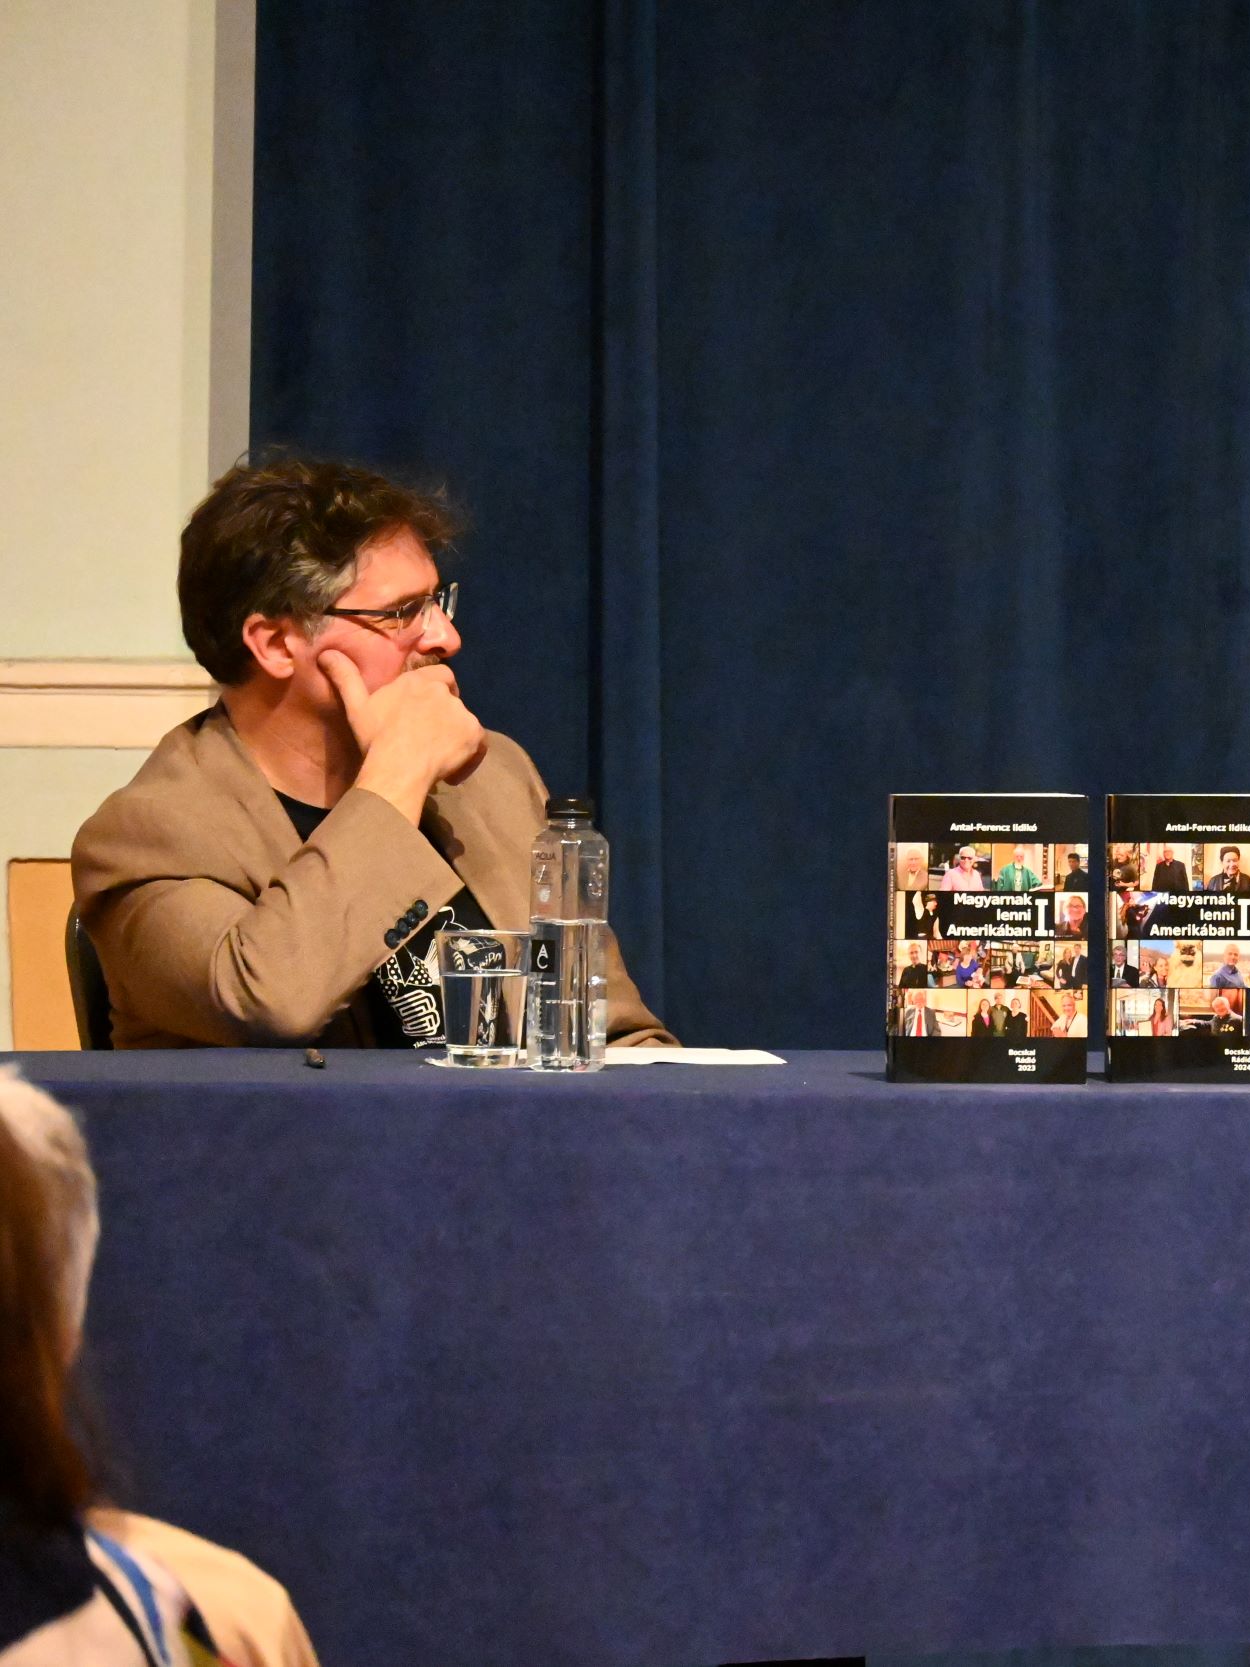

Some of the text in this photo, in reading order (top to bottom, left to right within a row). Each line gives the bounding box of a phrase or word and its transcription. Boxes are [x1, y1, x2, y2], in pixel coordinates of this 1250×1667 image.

[949, 822, 1038, 832] Antal-Ferencz Ildikó
[1165, 822, 1227, 832] Antal-Ferencz
[953, 892, 1032, 908] Magyarnak
[1157, 892, 1236, 908] Magyarnak
[996, 909, 1032, 921] lenni
[1199, 908, 1235, 921] lenni
[946, 924, 1032, 937] Amerikában
[1150, 923, 1235, 937] Amerikában
[1008, 1048, 1036, 1056] Bocskai
[1017, 1064, 1036, 1072] 2023
